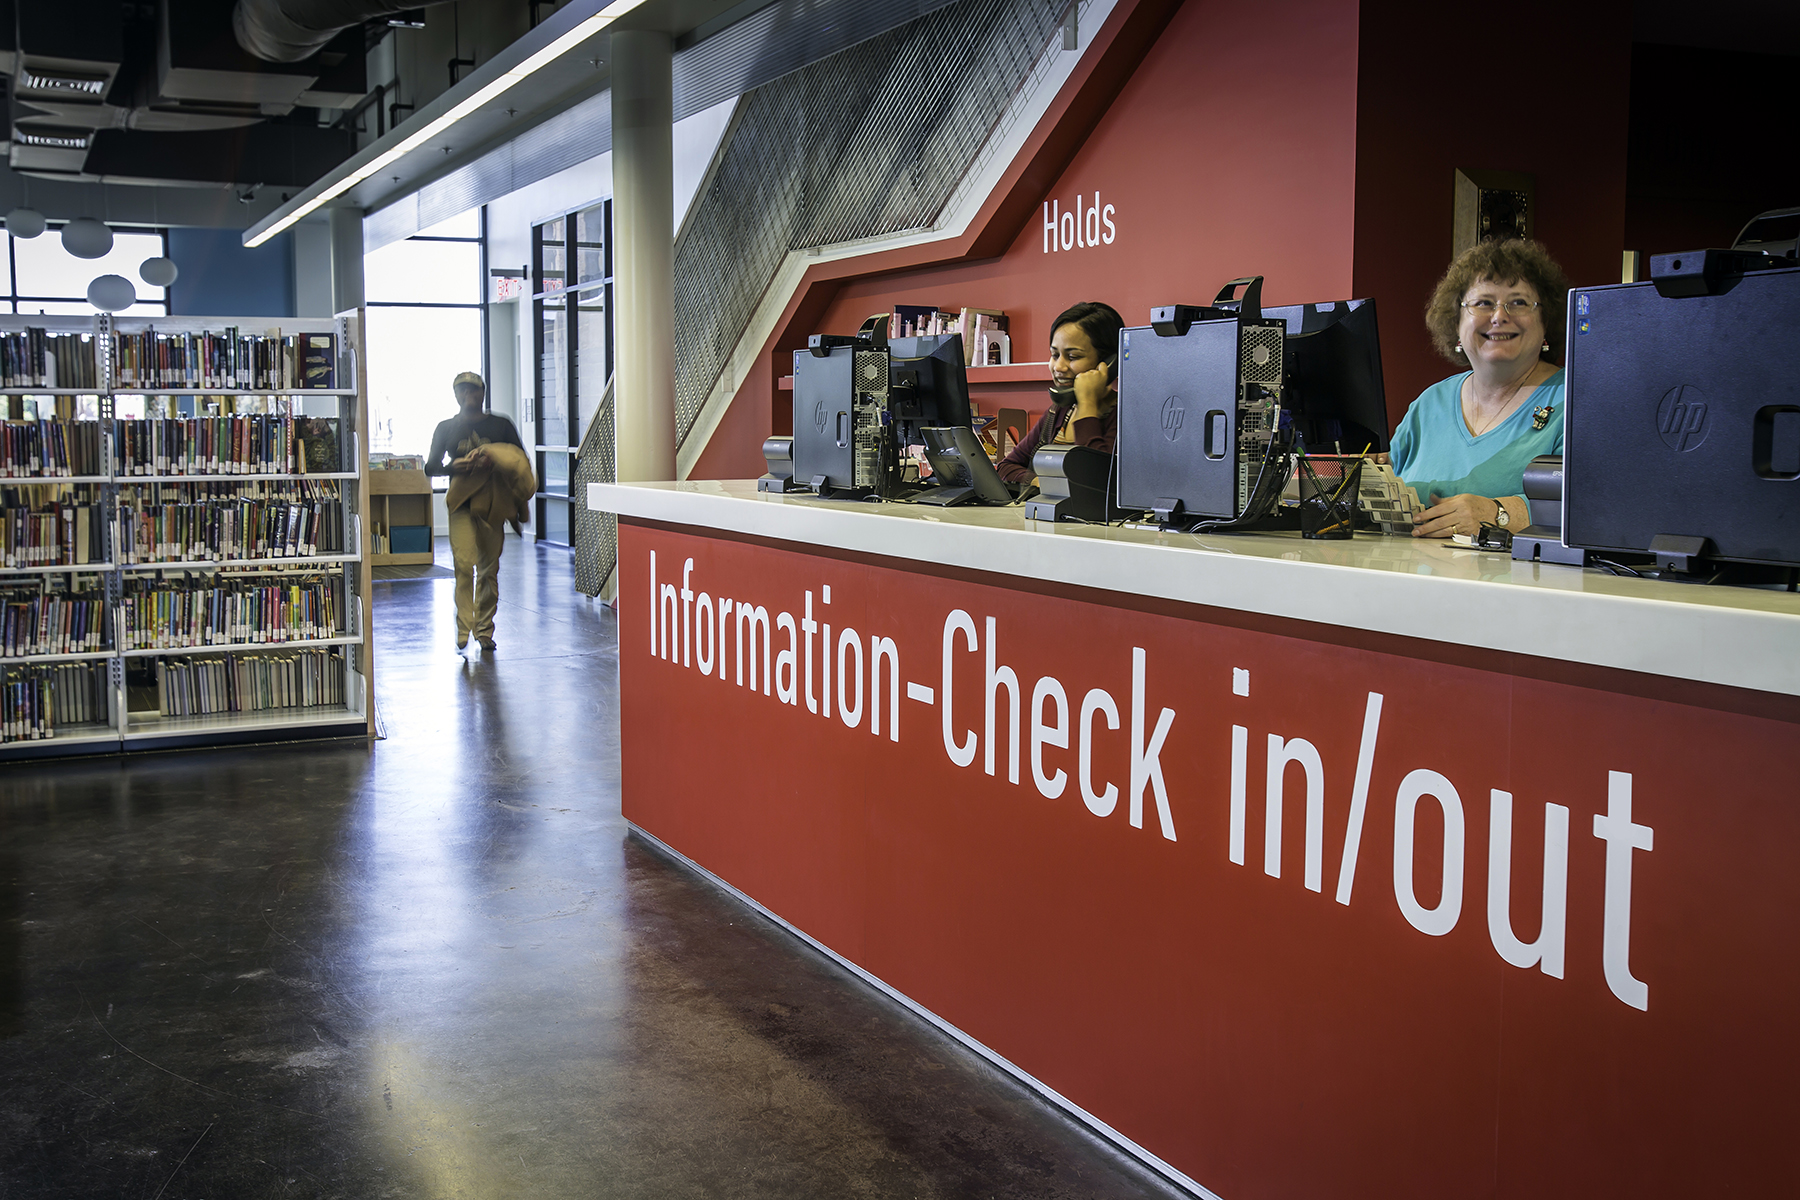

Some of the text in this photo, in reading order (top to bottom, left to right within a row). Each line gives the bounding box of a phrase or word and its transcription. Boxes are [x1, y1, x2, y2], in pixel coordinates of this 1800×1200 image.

[1043, 190, 1116, 254] Holds
[497, 279, 519, 297] EXIT
[1161, 395, 1186, 442] hp
[1657, 384, 1711, 452] hp
[650, 549, 1654, 1012] Information-Check in/out
